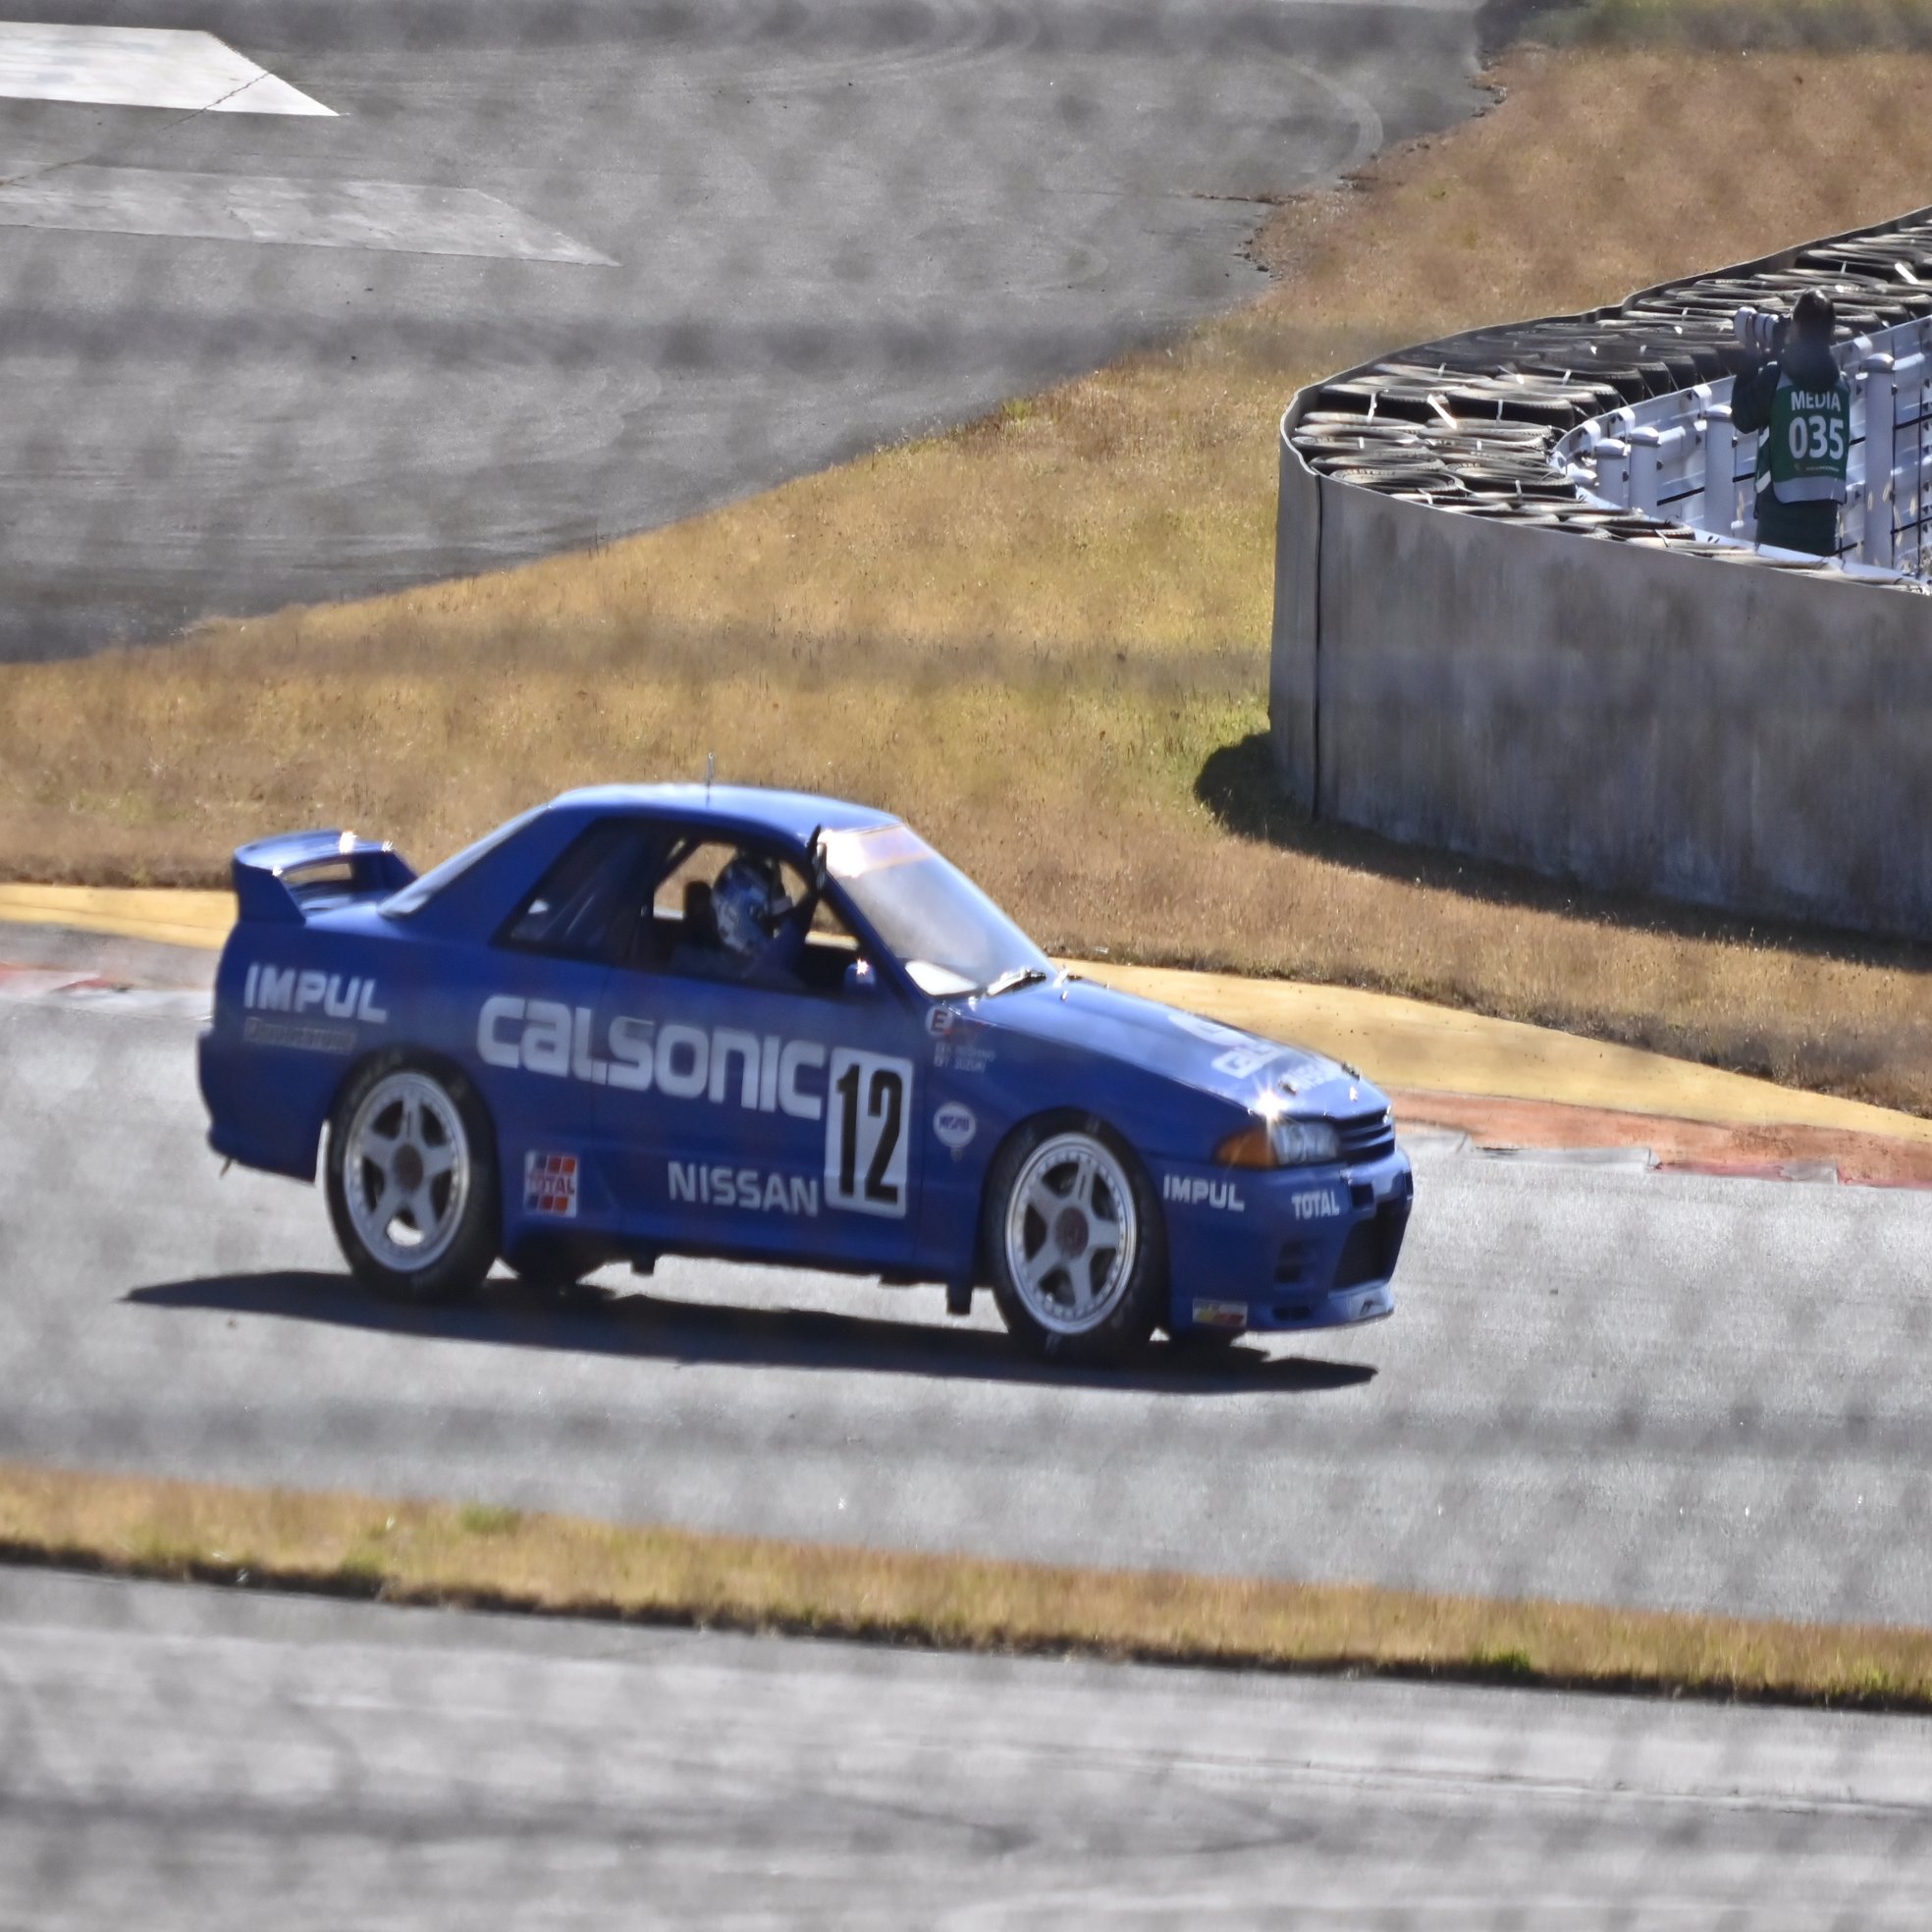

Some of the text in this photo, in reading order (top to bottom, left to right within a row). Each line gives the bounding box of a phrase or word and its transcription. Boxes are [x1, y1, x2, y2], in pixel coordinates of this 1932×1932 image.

[1791, 392, 1841, 411] MEDIA
[1788, 414, 1844, 459] 035
[243, 962, 388, 1024] IMPUL
[836, 1063, 902, 1205] 12
[668, 1160, 819, 1216] NISSAN
[1163, 1174, 1245, 1212] IMPUL
[1291, 1189, 1340, 1220] TOTAL
